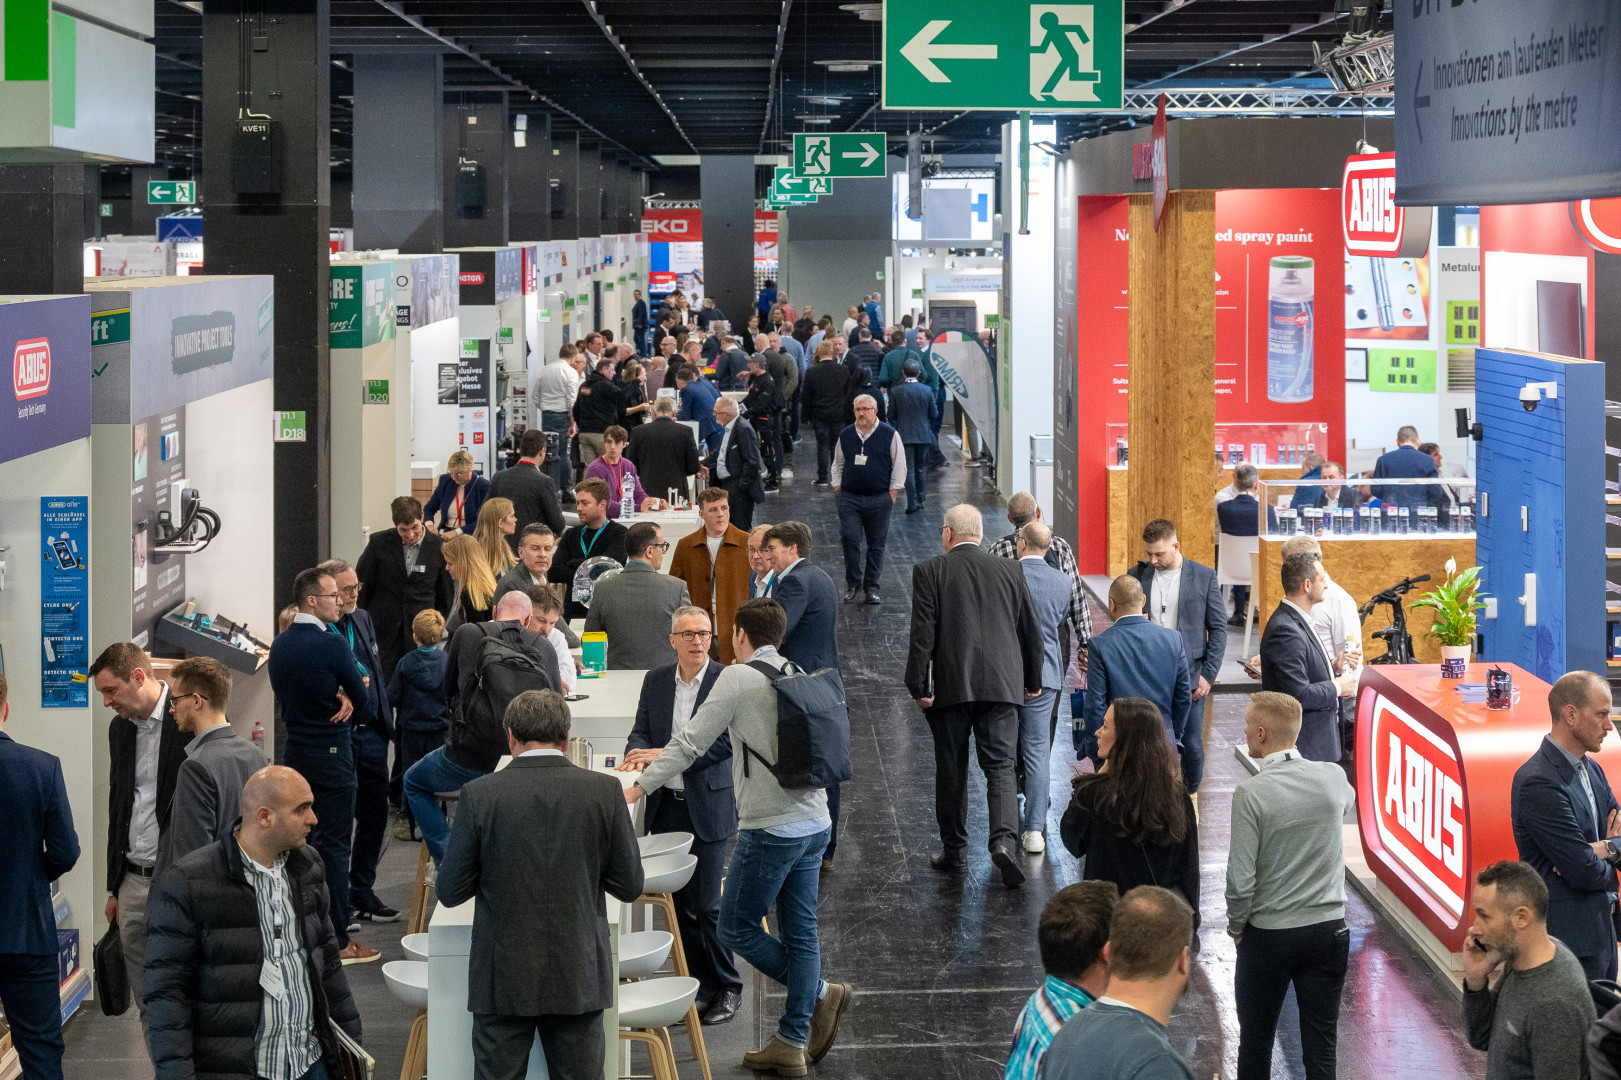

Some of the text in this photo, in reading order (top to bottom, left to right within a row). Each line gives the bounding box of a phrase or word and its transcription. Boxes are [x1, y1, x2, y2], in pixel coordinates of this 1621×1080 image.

[1433, 22, 1604, 91] Innovationen am laufenden Meter
[1450, 91, 1578, 145] Innovations by the metre
[1350, 176, 1395, 233] ABUS
[1234, 231, 1273, 245] spray
[1277, 228, 1313, 245] paint
[174, 325, 233, 359] INNOVATIVE PROJECT TOOLS
[18, 351, 47, 386] ABUS
[18, 406, 28, 419] Security
[35, 403, 46, 415] Germany
[281, 412, 296, 420] 11.1
[283, 429, 304, 439] D18
[1385, 731, 1463, 879] ABUS
